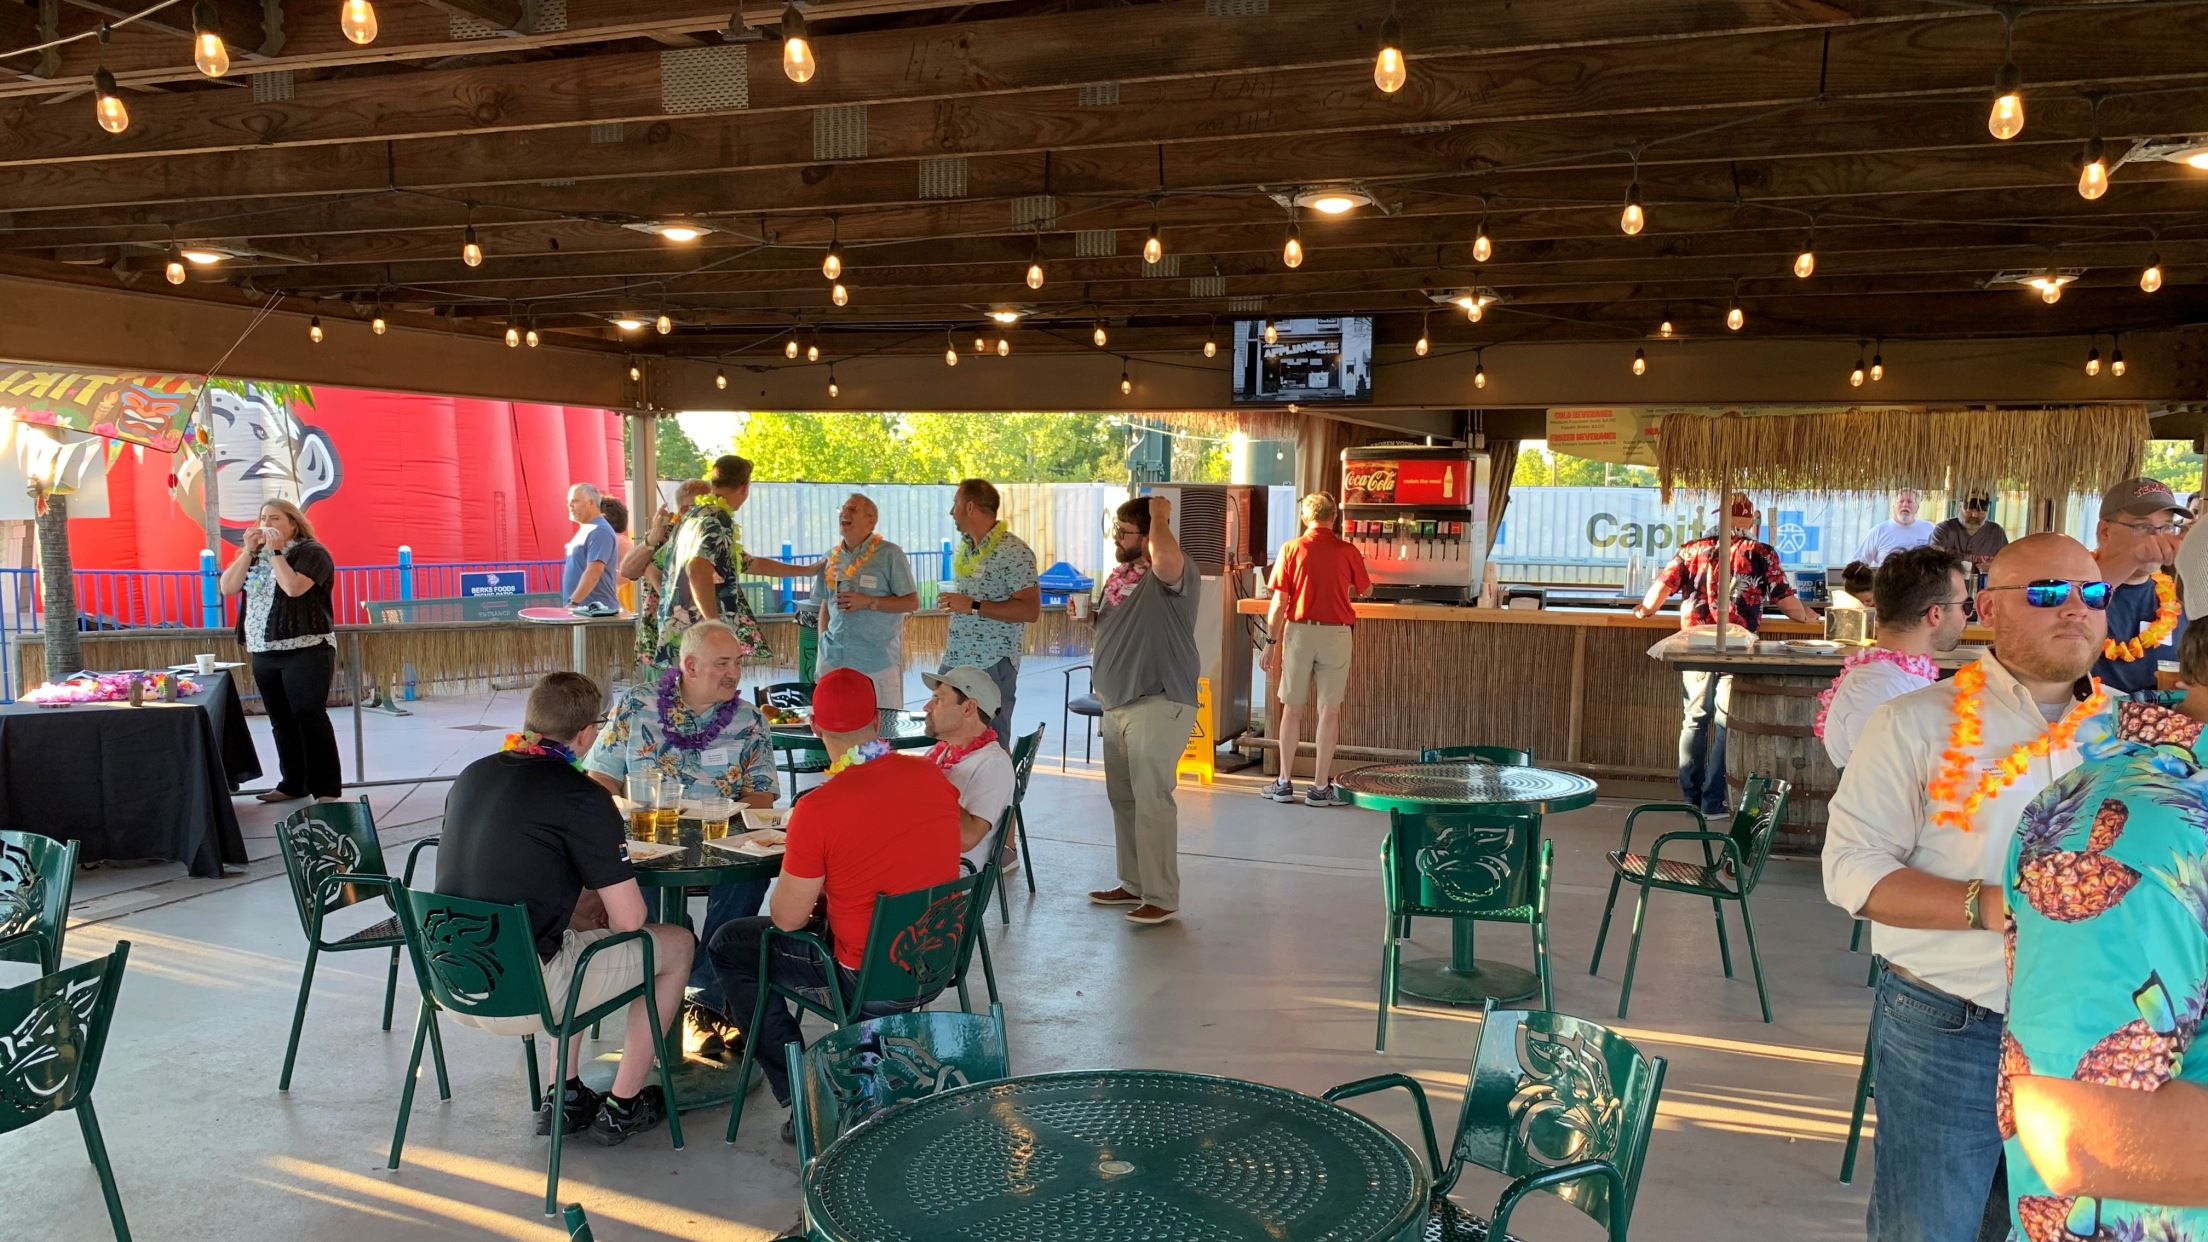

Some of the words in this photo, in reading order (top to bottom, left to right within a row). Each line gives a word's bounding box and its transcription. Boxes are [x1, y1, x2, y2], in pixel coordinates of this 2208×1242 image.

[1263, 341, 1326, 358] APPLIANCE
[1586, 512, 1706, 557] Capit
[494, 585, 516, 593] FOODS
